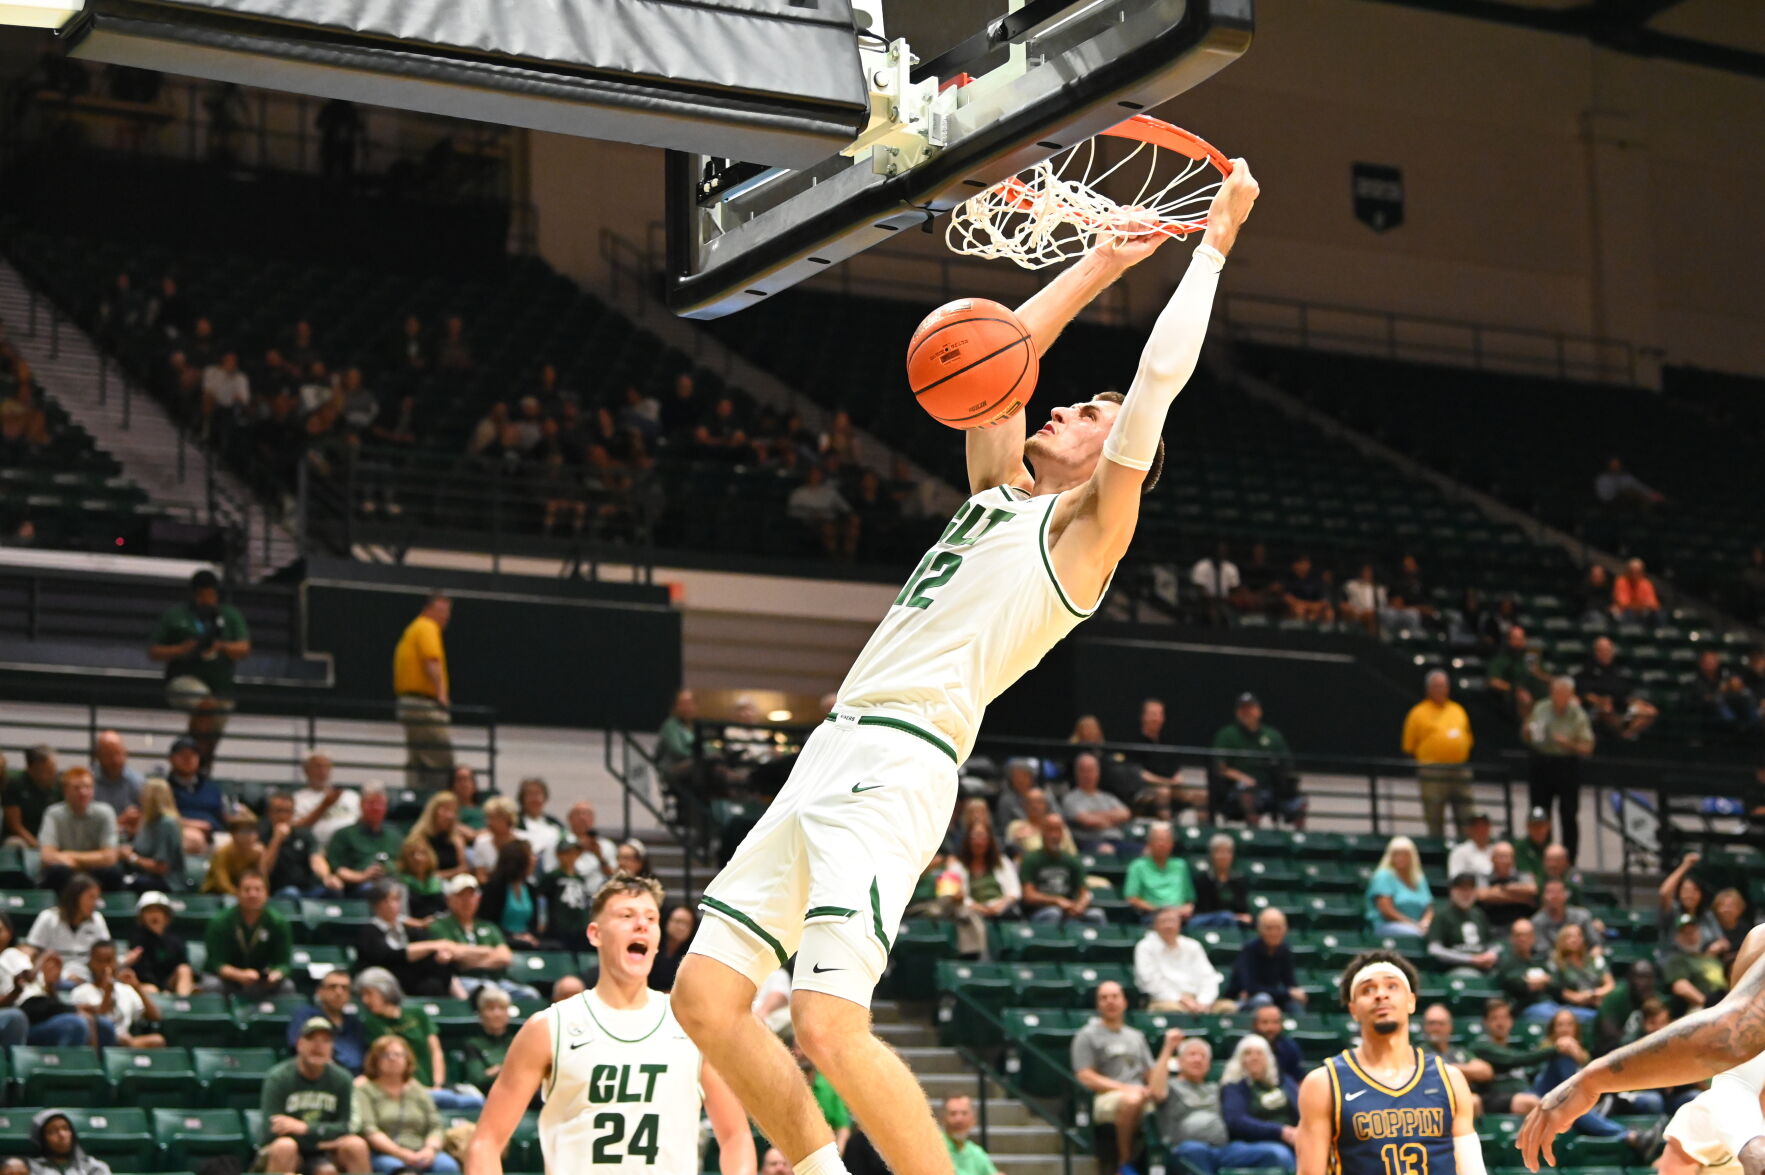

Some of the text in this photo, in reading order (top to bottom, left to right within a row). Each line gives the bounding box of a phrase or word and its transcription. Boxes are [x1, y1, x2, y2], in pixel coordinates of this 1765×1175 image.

[893, 551, 963, 610] 12
[588, 1063, 668, 1104] CLT
[592, 1112, 660, 1165] 24
[1352, 1107, 1444, 1141] COPPIN
[1381, 1142, 1429, 1175] 13
